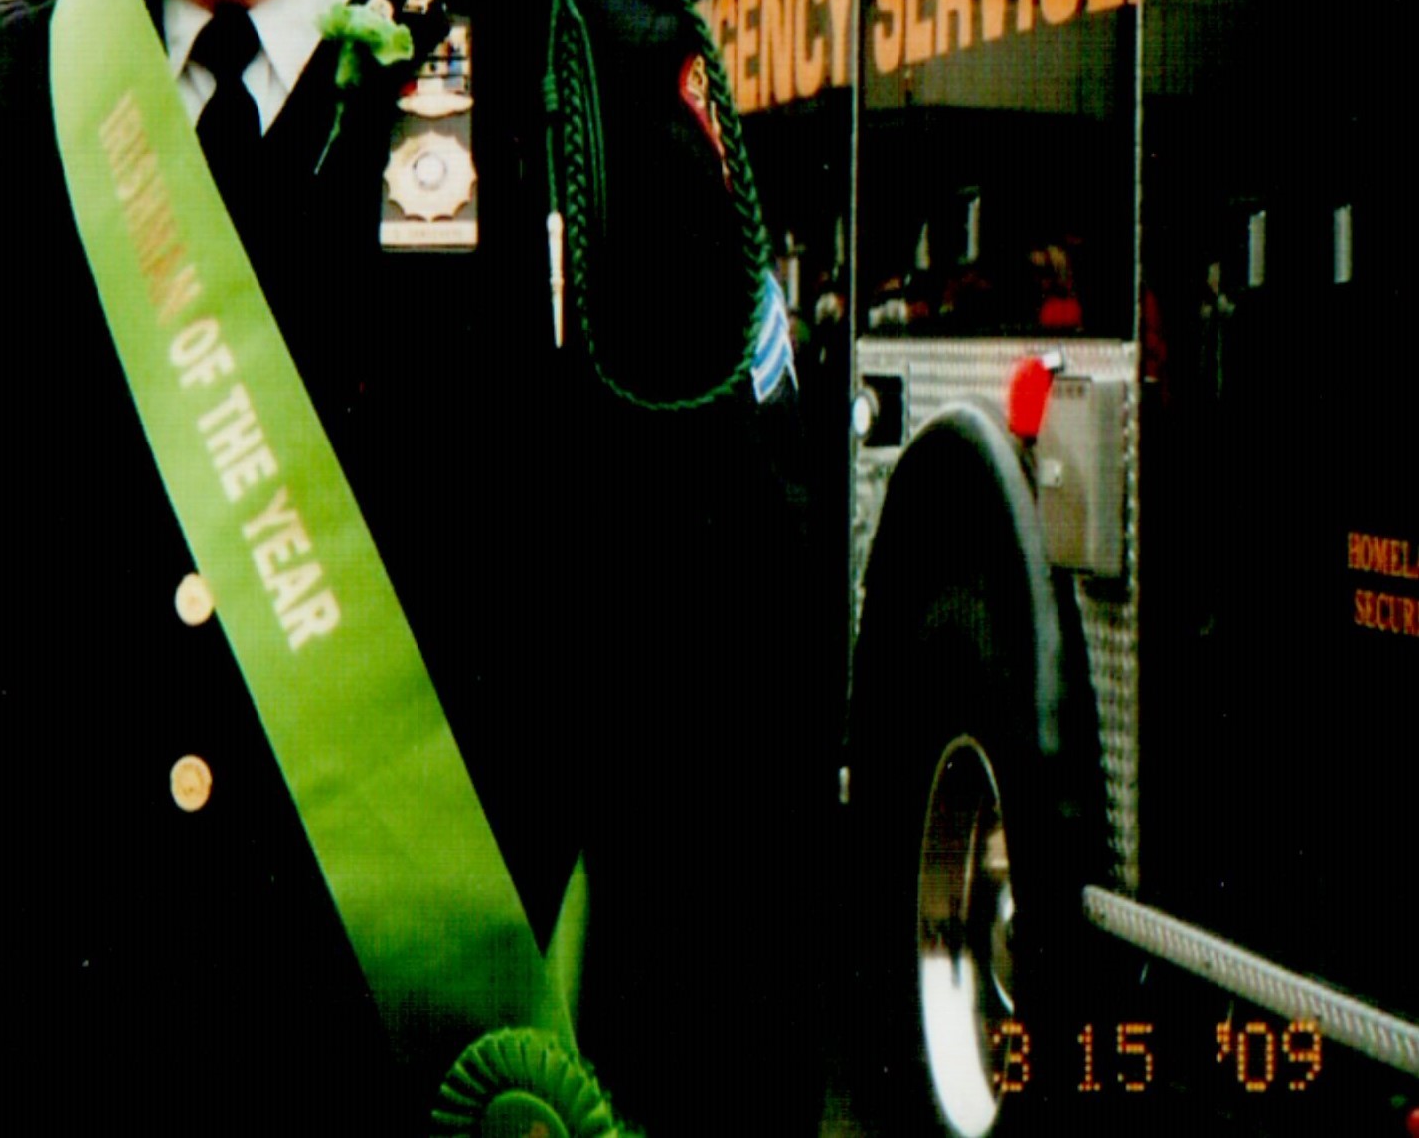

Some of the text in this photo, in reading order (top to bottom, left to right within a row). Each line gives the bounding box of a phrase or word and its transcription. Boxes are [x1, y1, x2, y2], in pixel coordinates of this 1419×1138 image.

[170, 318, 235, 389] OF
[197, 382, 279, 503] THE
[241, 485, 342, 652] YEAR
[1347, 530, 1419, 579] HOMEL
[1353, 588, 1419, 638] SECUR
